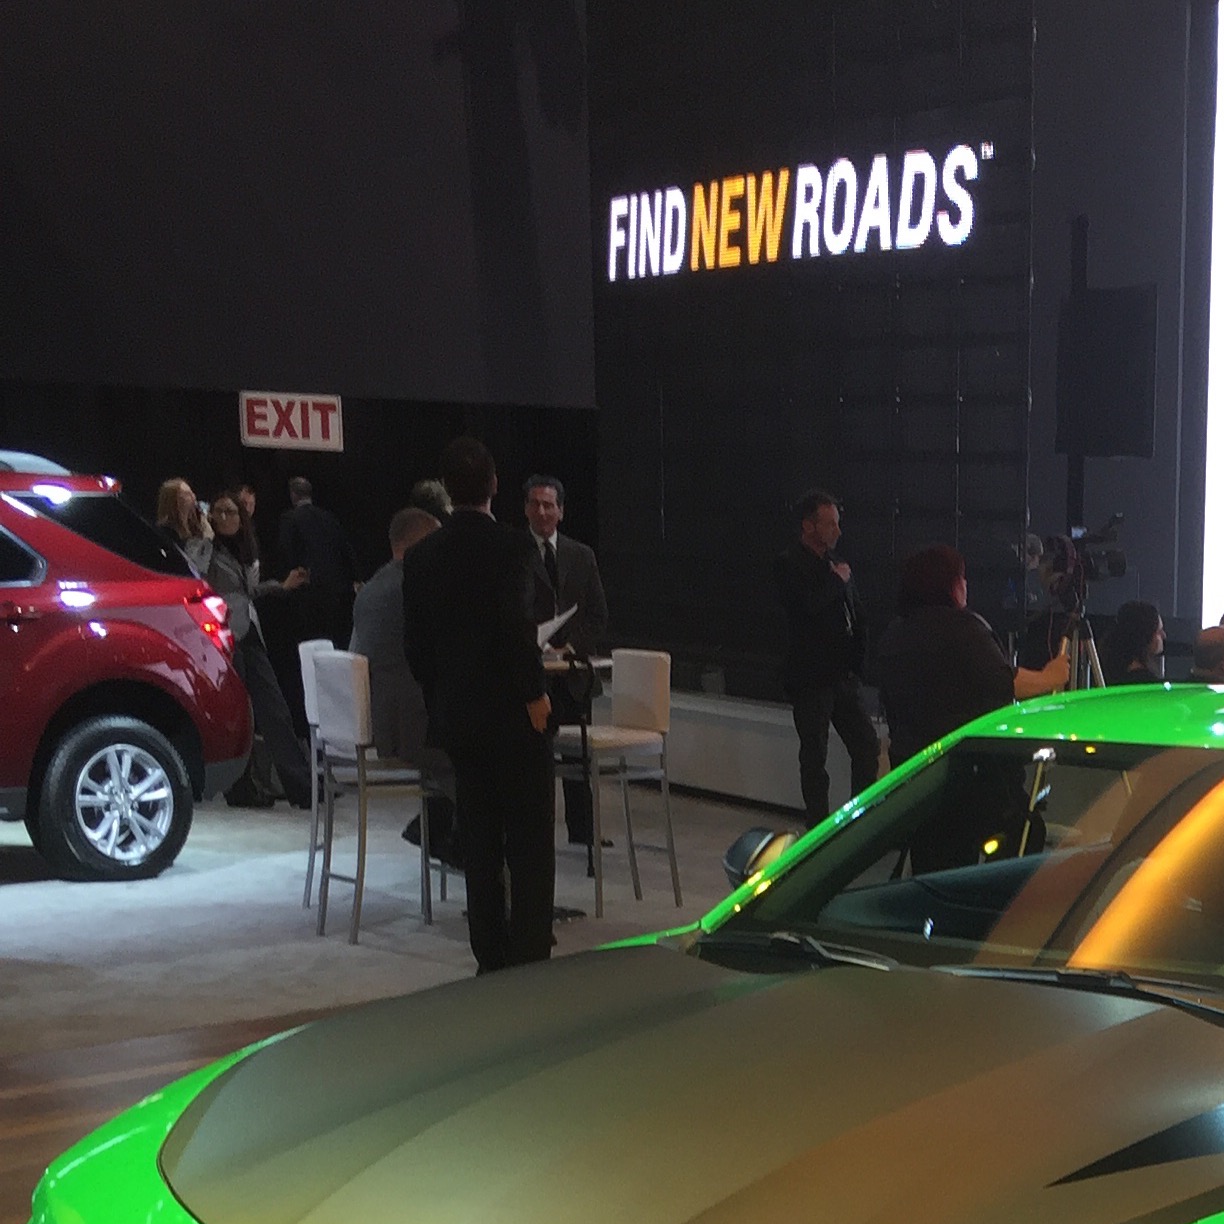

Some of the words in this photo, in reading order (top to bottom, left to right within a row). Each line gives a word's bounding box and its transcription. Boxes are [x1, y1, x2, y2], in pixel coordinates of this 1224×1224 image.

[608, 186, 686, 282] FIND
[690, 167, 790, 272] NEW
[791, 143, 978, 259] ROADS
[246, 398, 337, 441] EXIT
